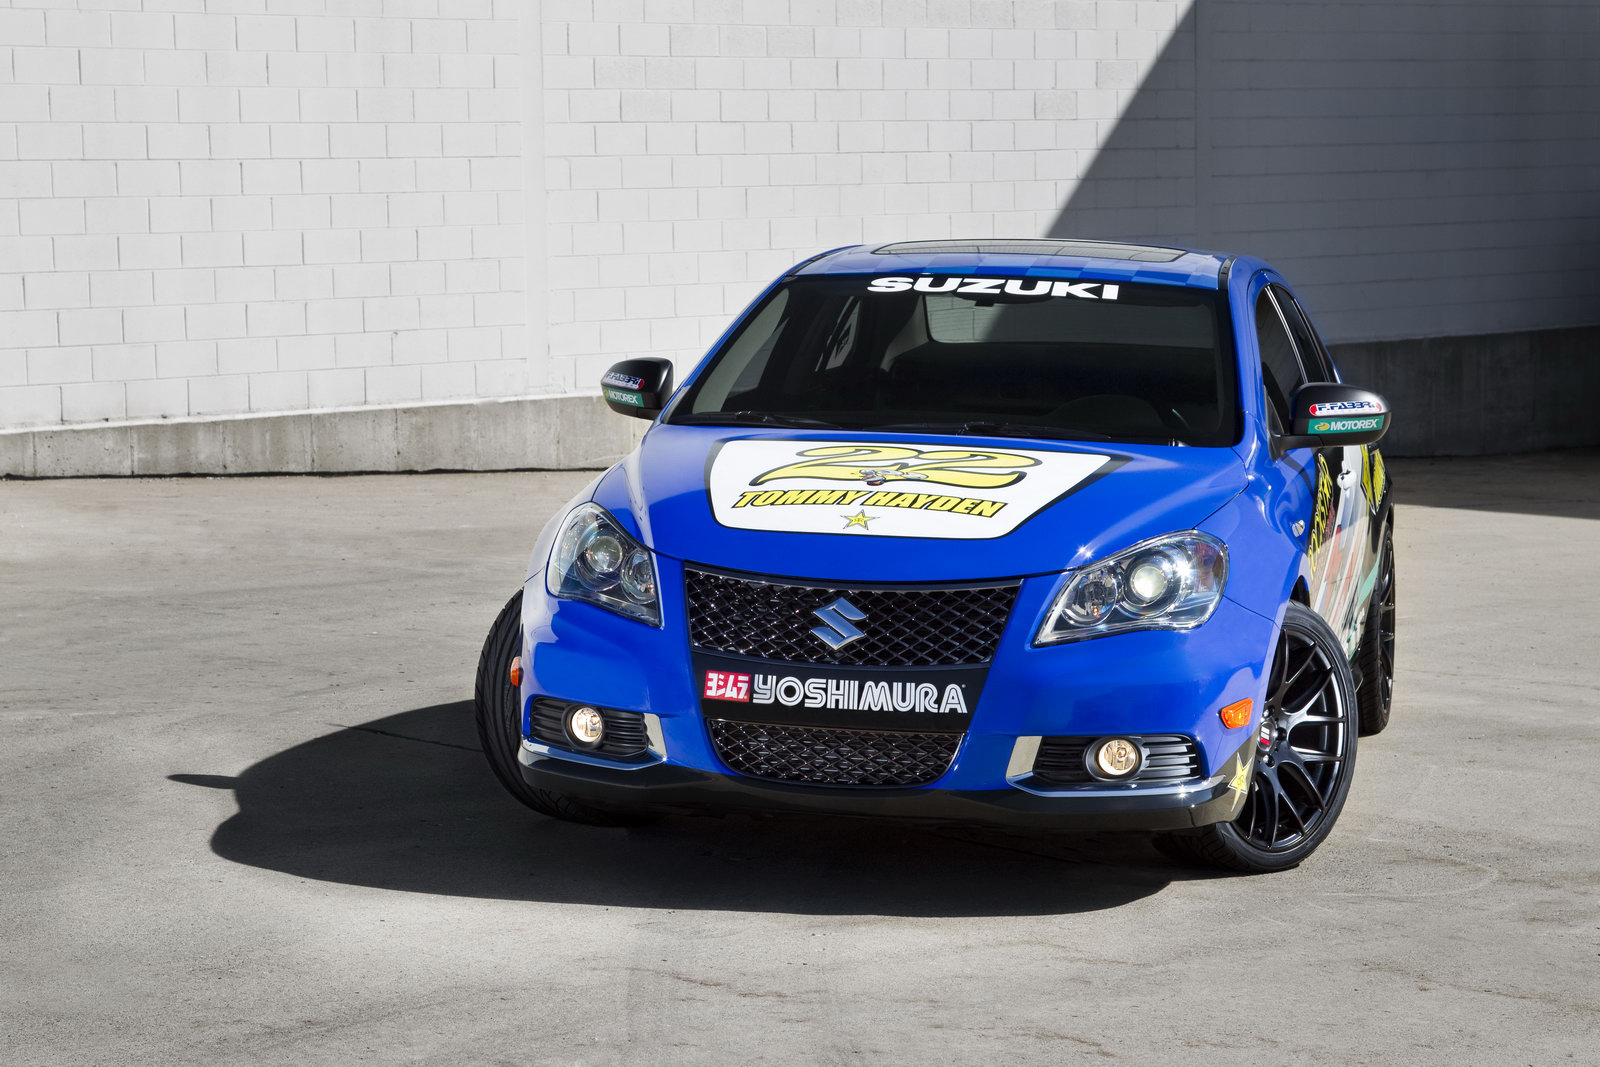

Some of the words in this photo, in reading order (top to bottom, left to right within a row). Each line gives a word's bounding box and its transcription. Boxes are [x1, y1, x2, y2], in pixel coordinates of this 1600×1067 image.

[867, 276, 1120, 300] SUZUKI
[608, 390, 639, 405] MOTOREX
[1330, 419, 1378, 431] MOTOREX
[748, 446, 1043, 489] 22
[731, 490, 870, 509] TOMMY
[860, 490, 1009, 519] HAYDEN
[752, 673, 969, 713] YOSHIMURA
